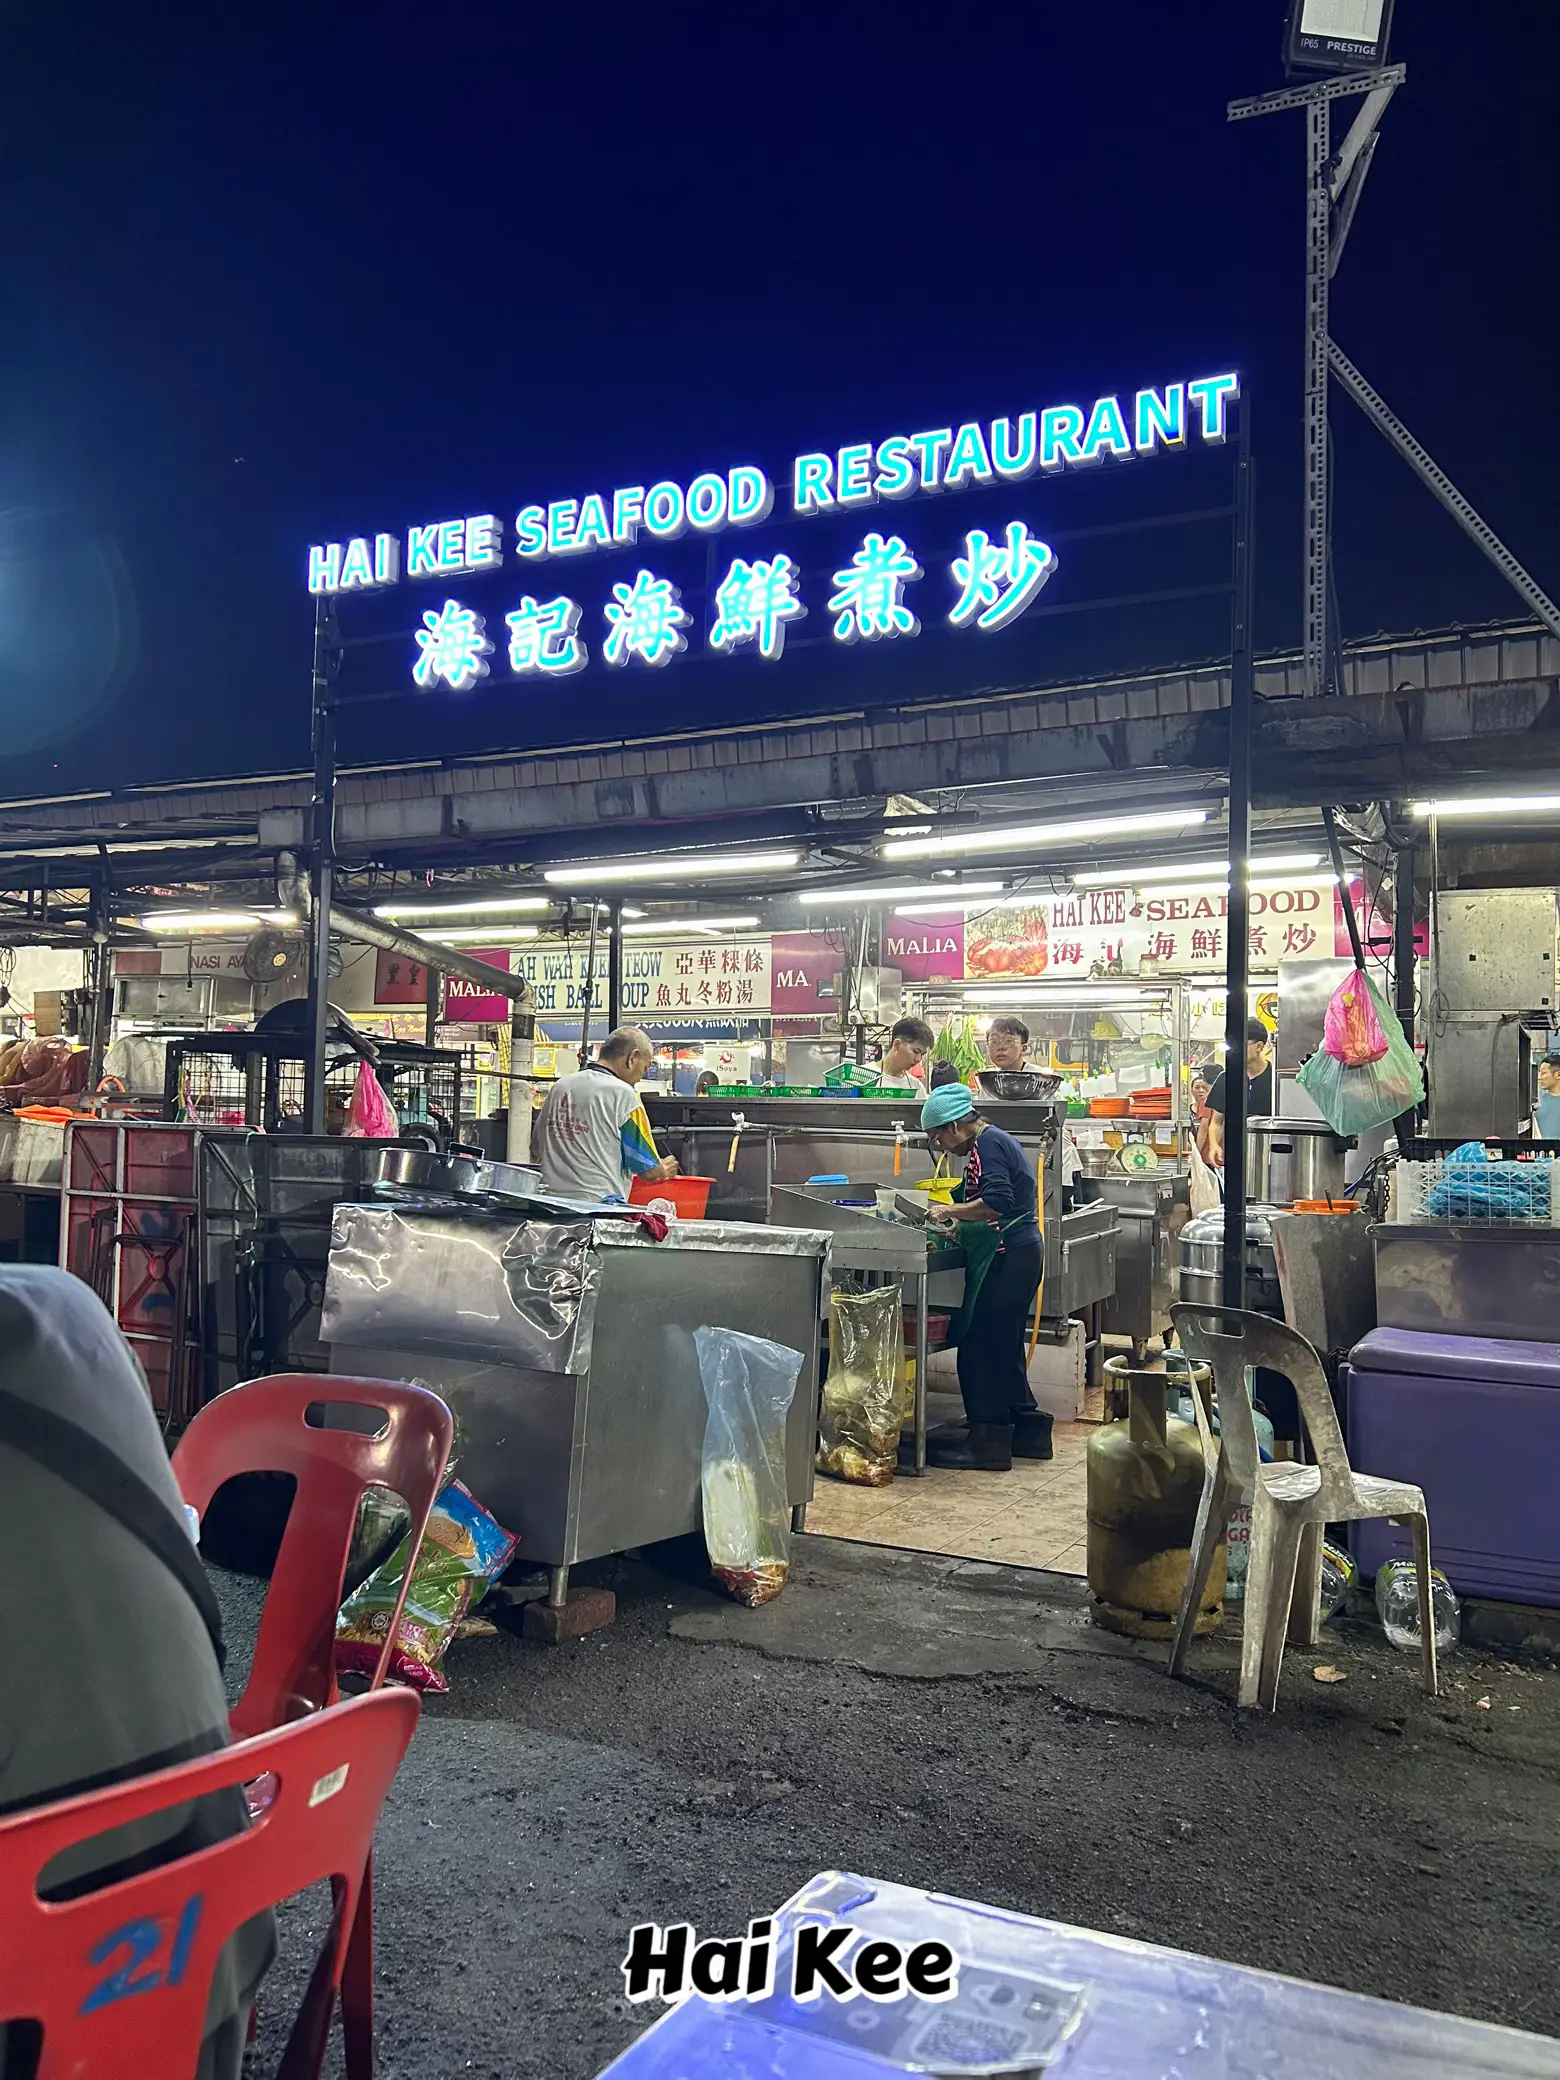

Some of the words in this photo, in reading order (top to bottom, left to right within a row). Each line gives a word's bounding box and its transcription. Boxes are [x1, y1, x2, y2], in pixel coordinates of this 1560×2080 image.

[1301, 38, 1319, 49] IP65
[1327, 41, 1377, 55] PRESTIGE
[308, 532, 396, 594] HAI
[406, 513, 502, 577] KEE
[515, 465, 774, 560] SEAFOOD
[794, 373, 1239, 512] RESTAURANT
[412, 520, 1058, 690] 海記海鮮煮炒
[1052, 899, 1083, 928] HAI
[1089, 890, 1126, 926] KEE
[887, 936, 959, 956] MALIA
[190, 955, 221, 969] NASI
[518, 956, 536, 981] AH
[543, 954, 574, 980] WAH
[580, 952, 611, 979] KUE
[625, 951, 663, 978] TEOW
[675, 949, 764, 976] 亞華粿條
[566, 984, 602, 1009] BALL
[621, 982, 650, 1009] OUP
[656, 979, 754, 1008] 魚丸冬粉湯
[79, 1893, 206, 2016] 21
